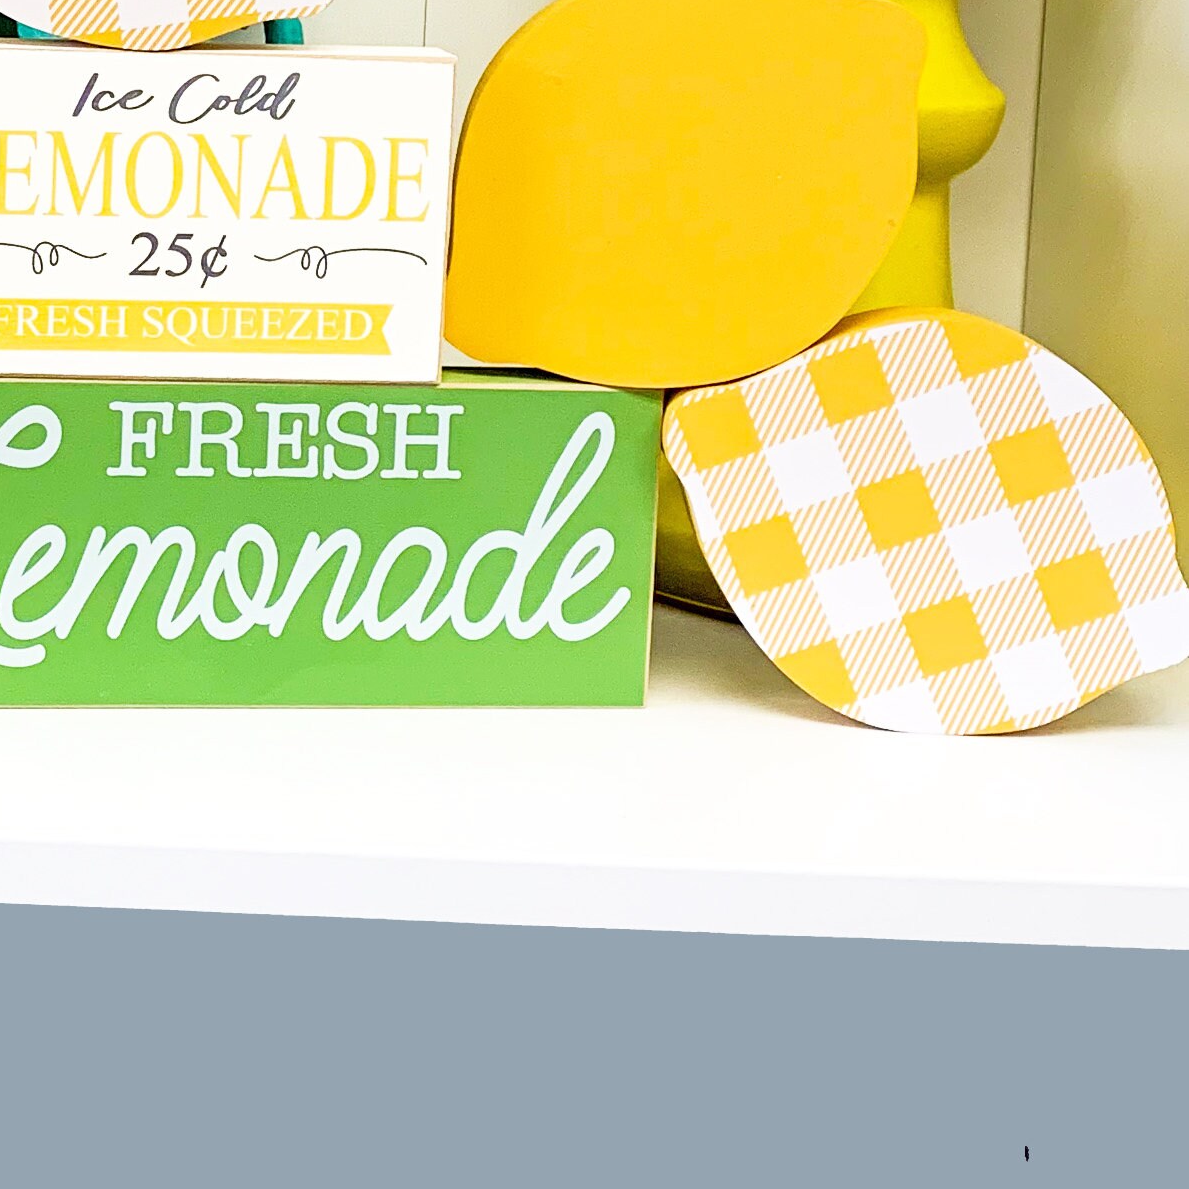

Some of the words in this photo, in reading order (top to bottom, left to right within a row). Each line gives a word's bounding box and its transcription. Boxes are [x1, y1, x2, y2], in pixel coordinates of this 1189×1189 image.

[72, 72, 154, 117] Ice
[168, 72, 301, 124] Cold
[128, 231, 229, 289] 25¢
[141, 305, 375, 346] SQUEEZED
[106, 399, 466, 481] FRESH
